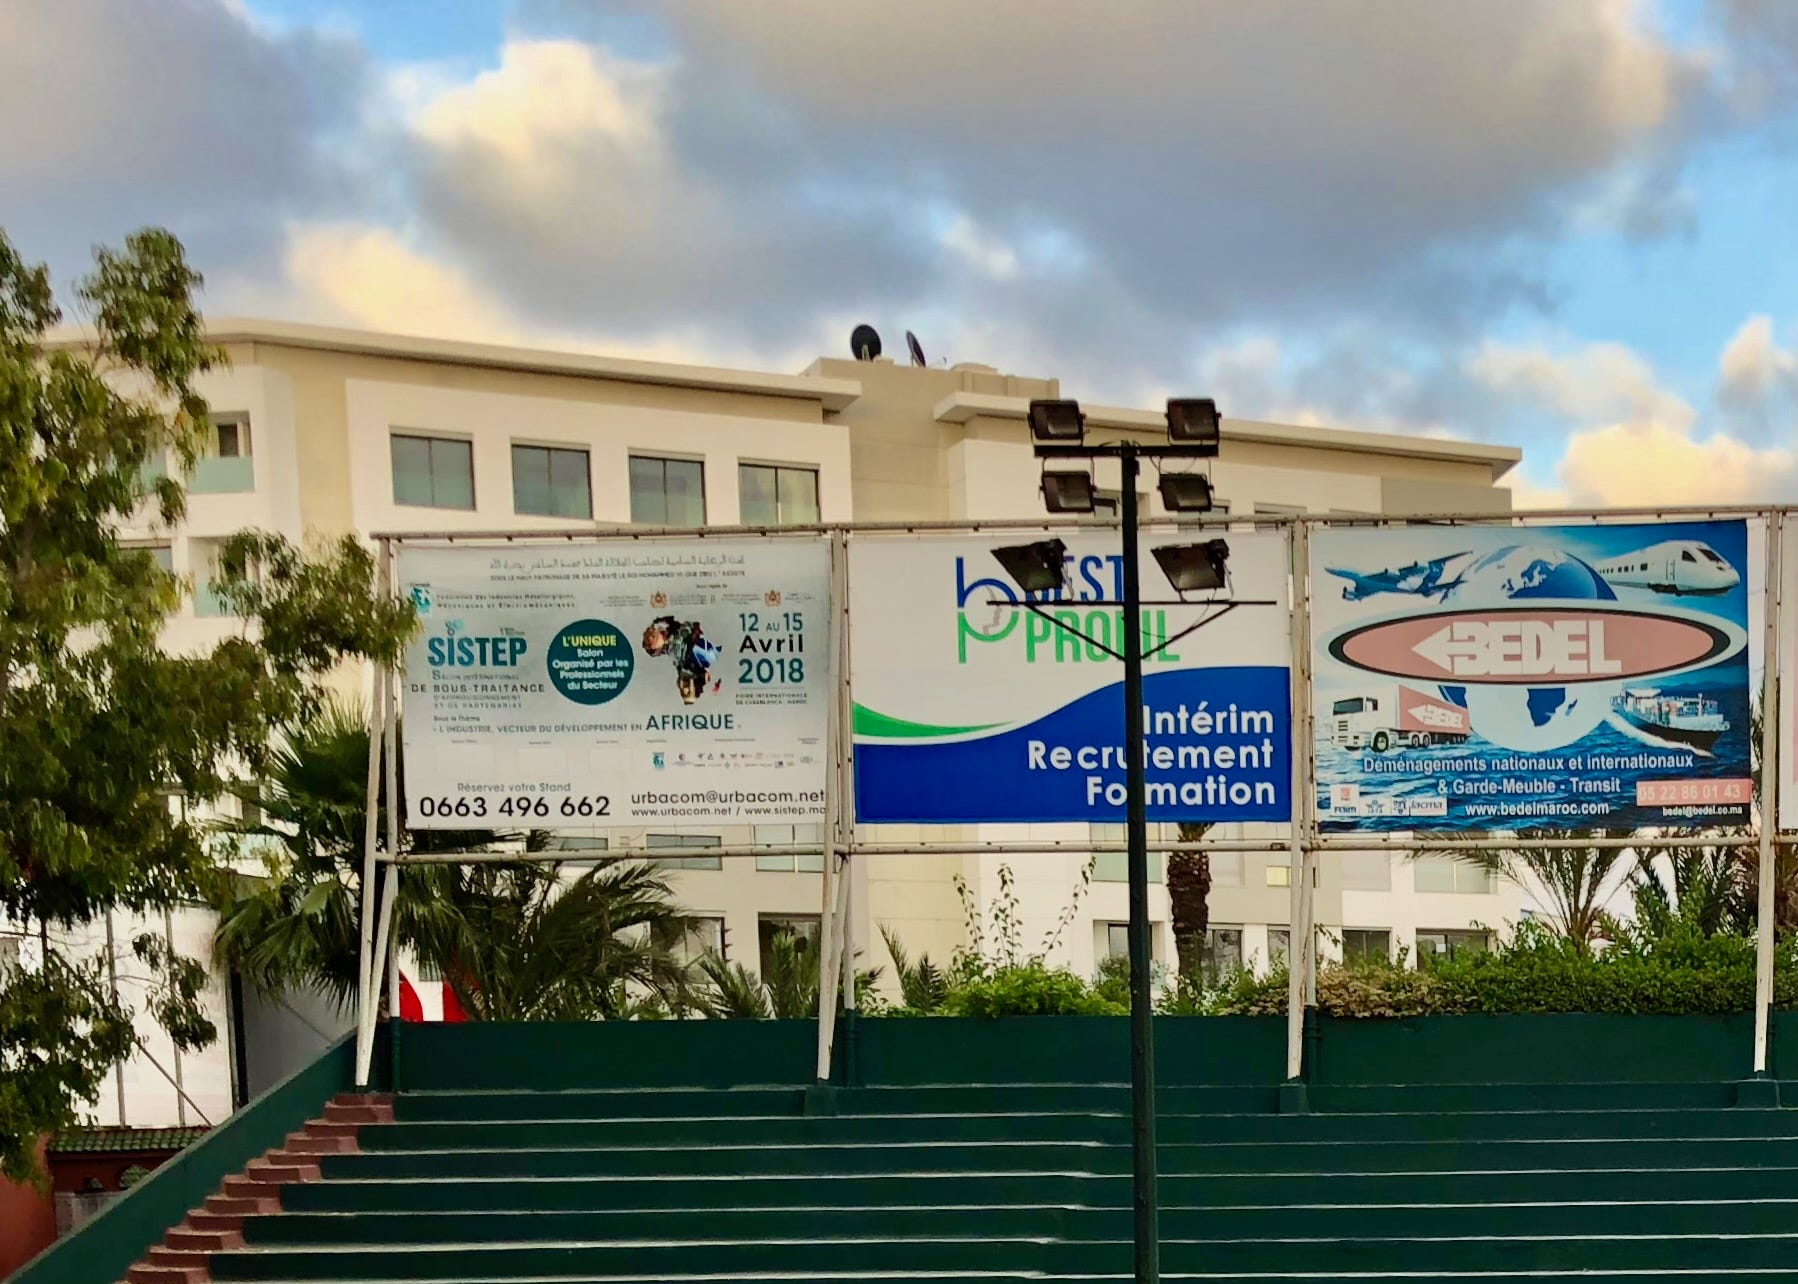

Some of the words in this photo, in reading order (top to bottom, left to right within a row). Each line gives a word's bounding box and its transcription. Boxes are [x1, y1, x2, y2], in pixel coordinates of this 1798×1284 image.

[739, 612, 759, 632] 12
[766, 622, 780, 632] AU
[783, 612, 803, 632] 15
[562, 635, 616, 647] L'UNIQUE
[739, 634, 803, 653] Avril
[1451, 619, 1622, 676] BEDEL
[428, 636, 528, 667] SISTEP
[576, 648, 604, 658] Salon
[738, 658, 804, 684] 2018
[582, 680, 618, 690] Secteur
[646, 714, 734, 730] AFRIQUE
[1142, 700, 1274, 735] Intérim
[1027, 738, 1274, 770] Recrutement
[1364, 756, 1487, 776] Déménagements
[1492, 756, 1564, 771] nationaux
[1568, 756, 1583, 770] et
[1587, 753, 1693, 769] internationaux
[457, 782, 505, 792] Réservez
[508, 783, 536, 792] votre
[540, 782, 571, 792] Stand
[1086, 774, 1276, 806] Fomation
[1437, 780, 1449, 795] &
[1452, 778, 1556, 795] Garde-Meuble
[1569, 778, 1621, 794] Transit
[1661, 786, 1676, 800] 22
[631, 790, 825, 804] urbacom@urbacom.net
[420, 796, 488, 817] 0663
[498, 796, 550, 817] 496
[560, 796, 611, 817] 662
[631, 806, 732, 816] www.urbacom.net
[1465, 801, 1610, 816] www.bedelmaroc.com
